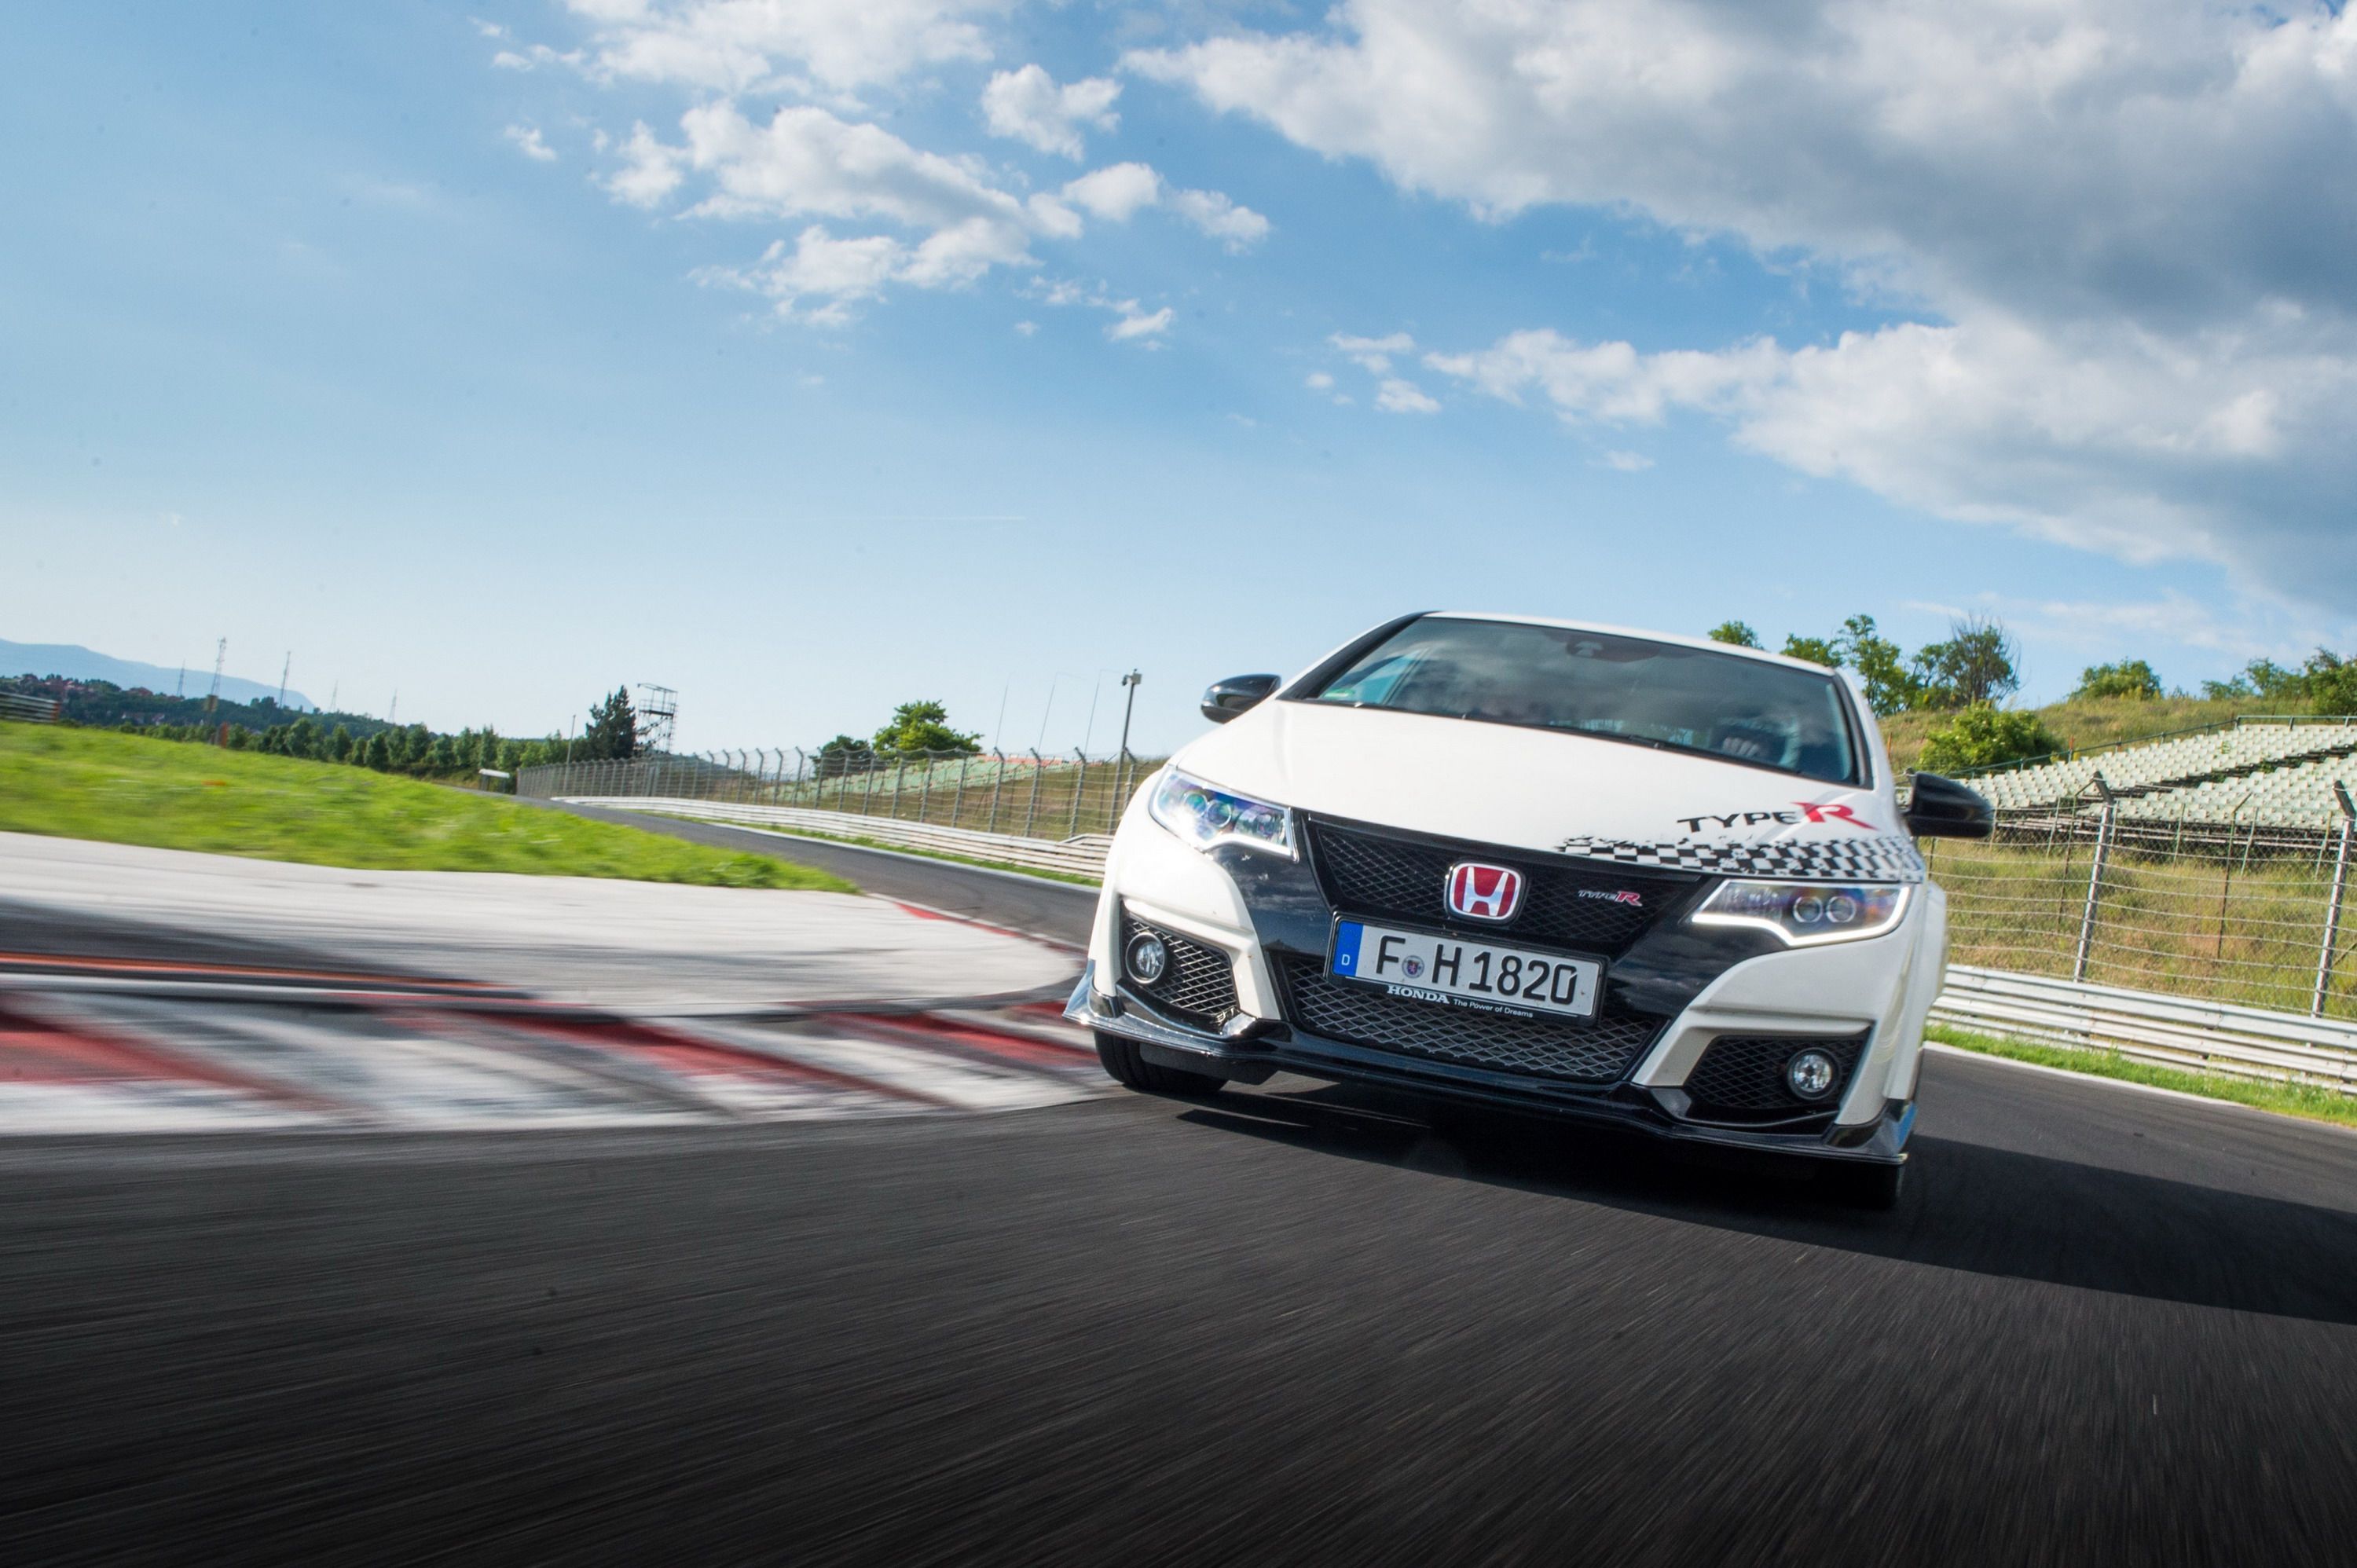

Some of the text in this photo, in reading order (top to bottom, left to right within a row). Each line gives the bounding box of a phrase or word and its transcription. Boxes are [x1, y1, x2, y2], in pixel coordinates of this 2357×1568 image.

[1677, 801, 1879, 833] TYPE R
[1341, 954, 1351, 966] D
[1376, 935, 1406, 974] F
[1387, 985, 1450, 1004] HONDA
[1453, 998, 1468, 1008] The
[1469, 1002, 1494, 1012] Power
[1505, 1007, 1534, 1018] Dreams
